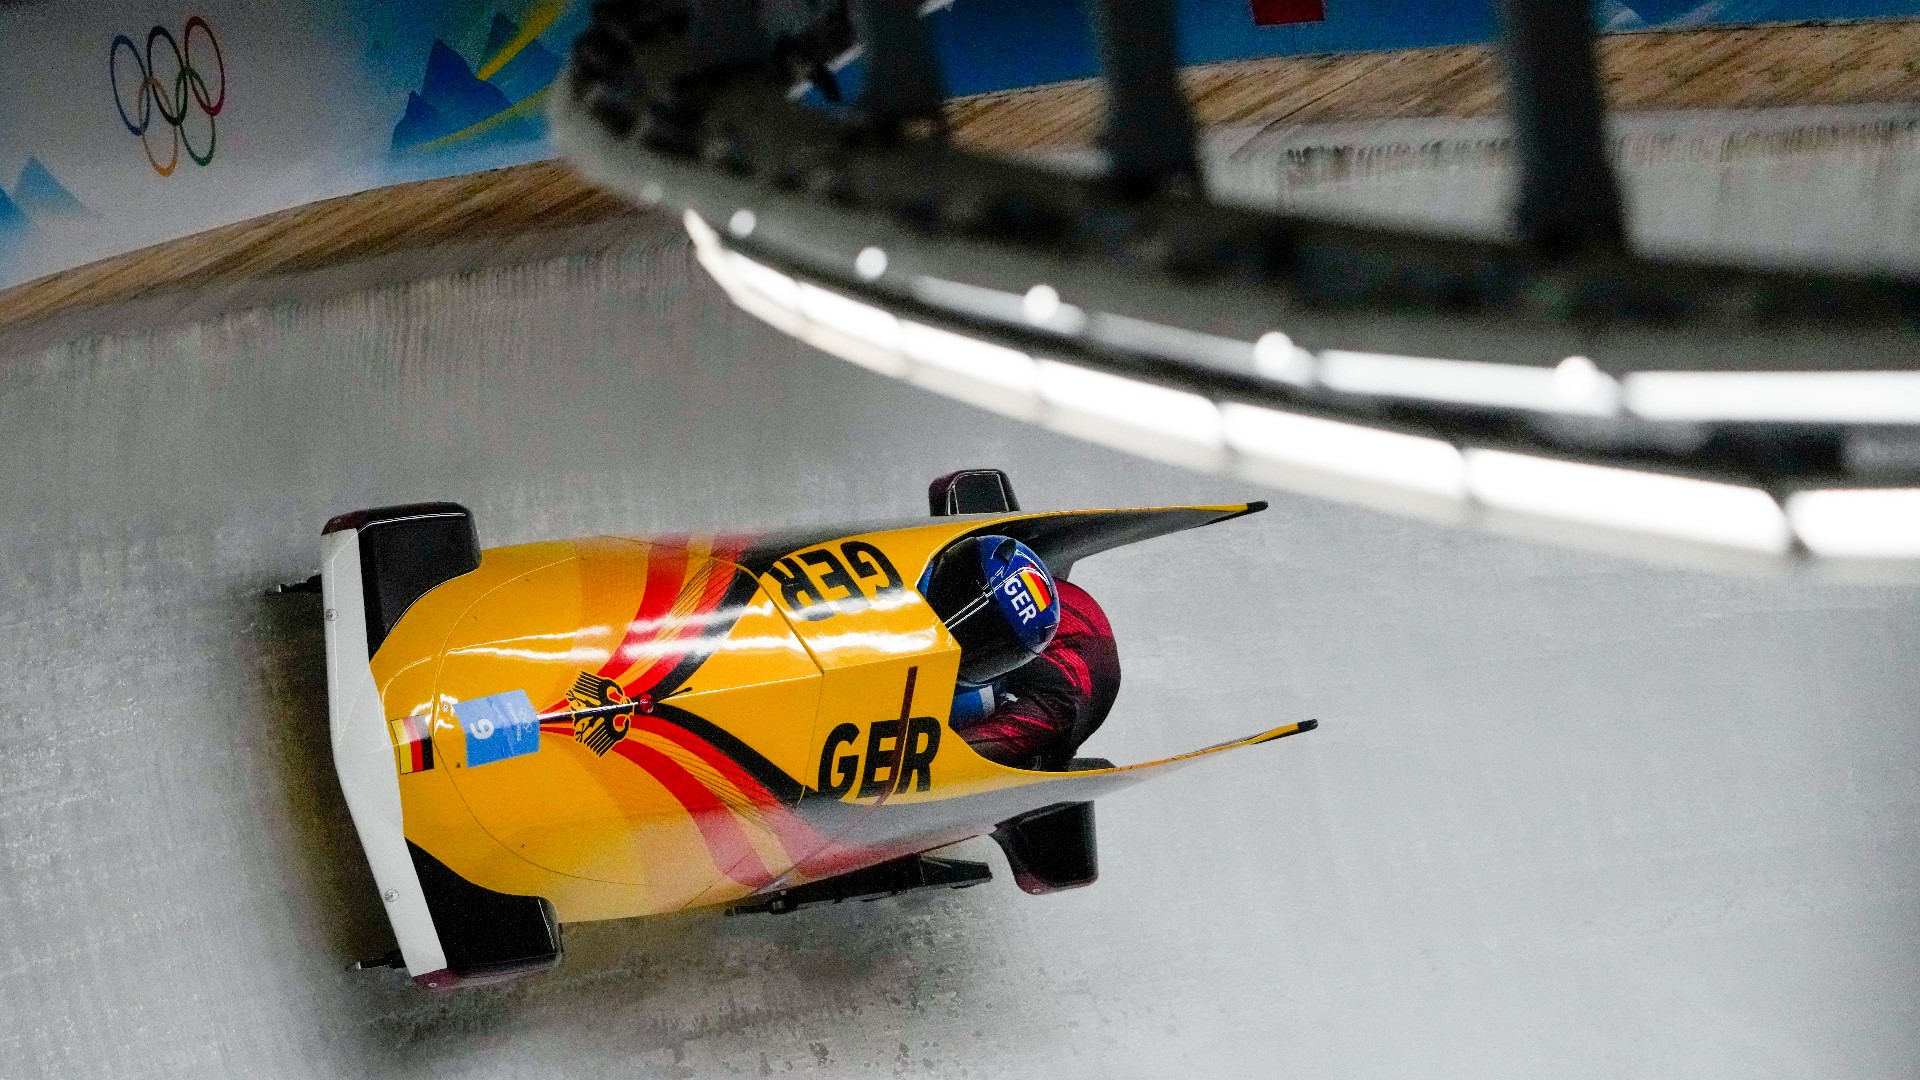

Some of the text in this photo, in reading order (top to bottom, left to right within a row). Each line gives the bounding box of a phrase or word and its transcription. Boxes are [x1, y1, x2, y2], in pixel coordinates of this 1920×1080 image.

[767, 540, 905, 622] GER
[1004, 577, 1037, 625] GER
[817, 716, 941, 800] GER
